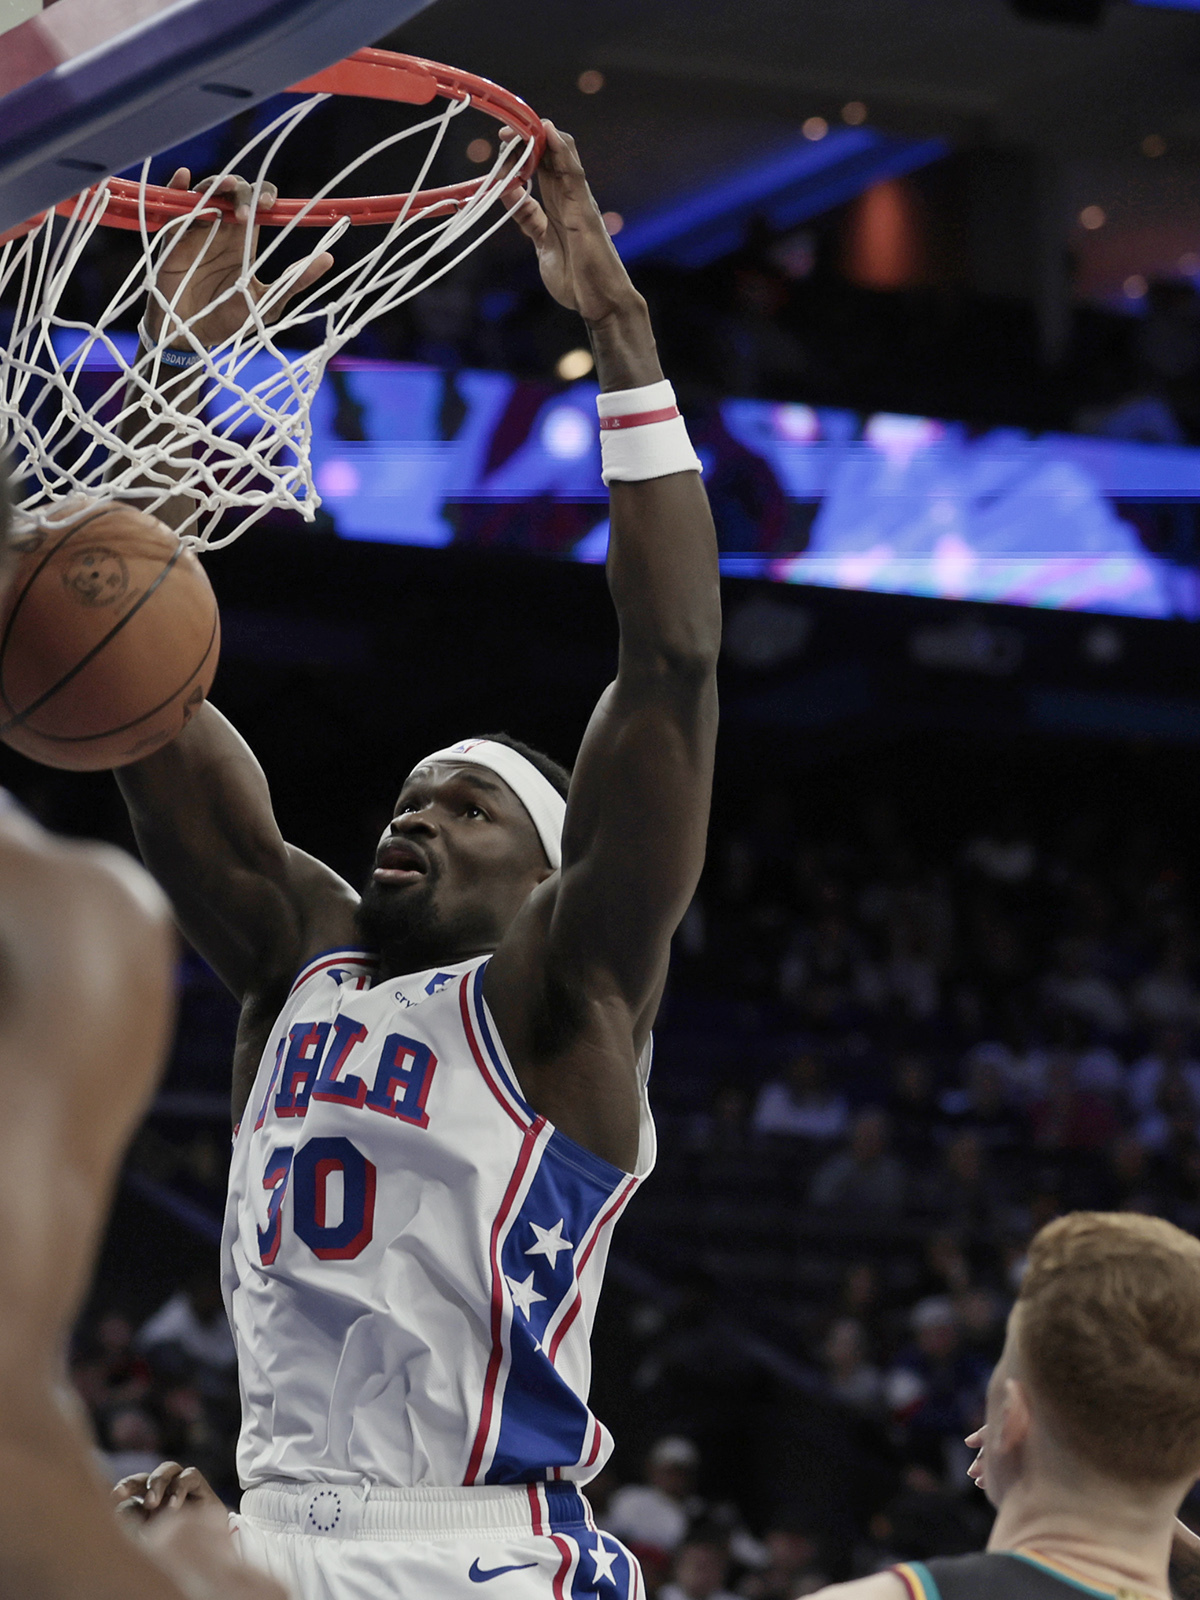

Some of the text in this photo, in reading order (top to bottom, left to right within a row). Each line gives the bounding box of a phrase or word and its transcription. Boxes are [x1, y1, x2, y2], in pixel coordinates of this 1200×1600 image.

[161, 350, 188, 366] ESDAY
[394, 991, 418, 1009] cry
[256, 1136, 377, 1267] 30
